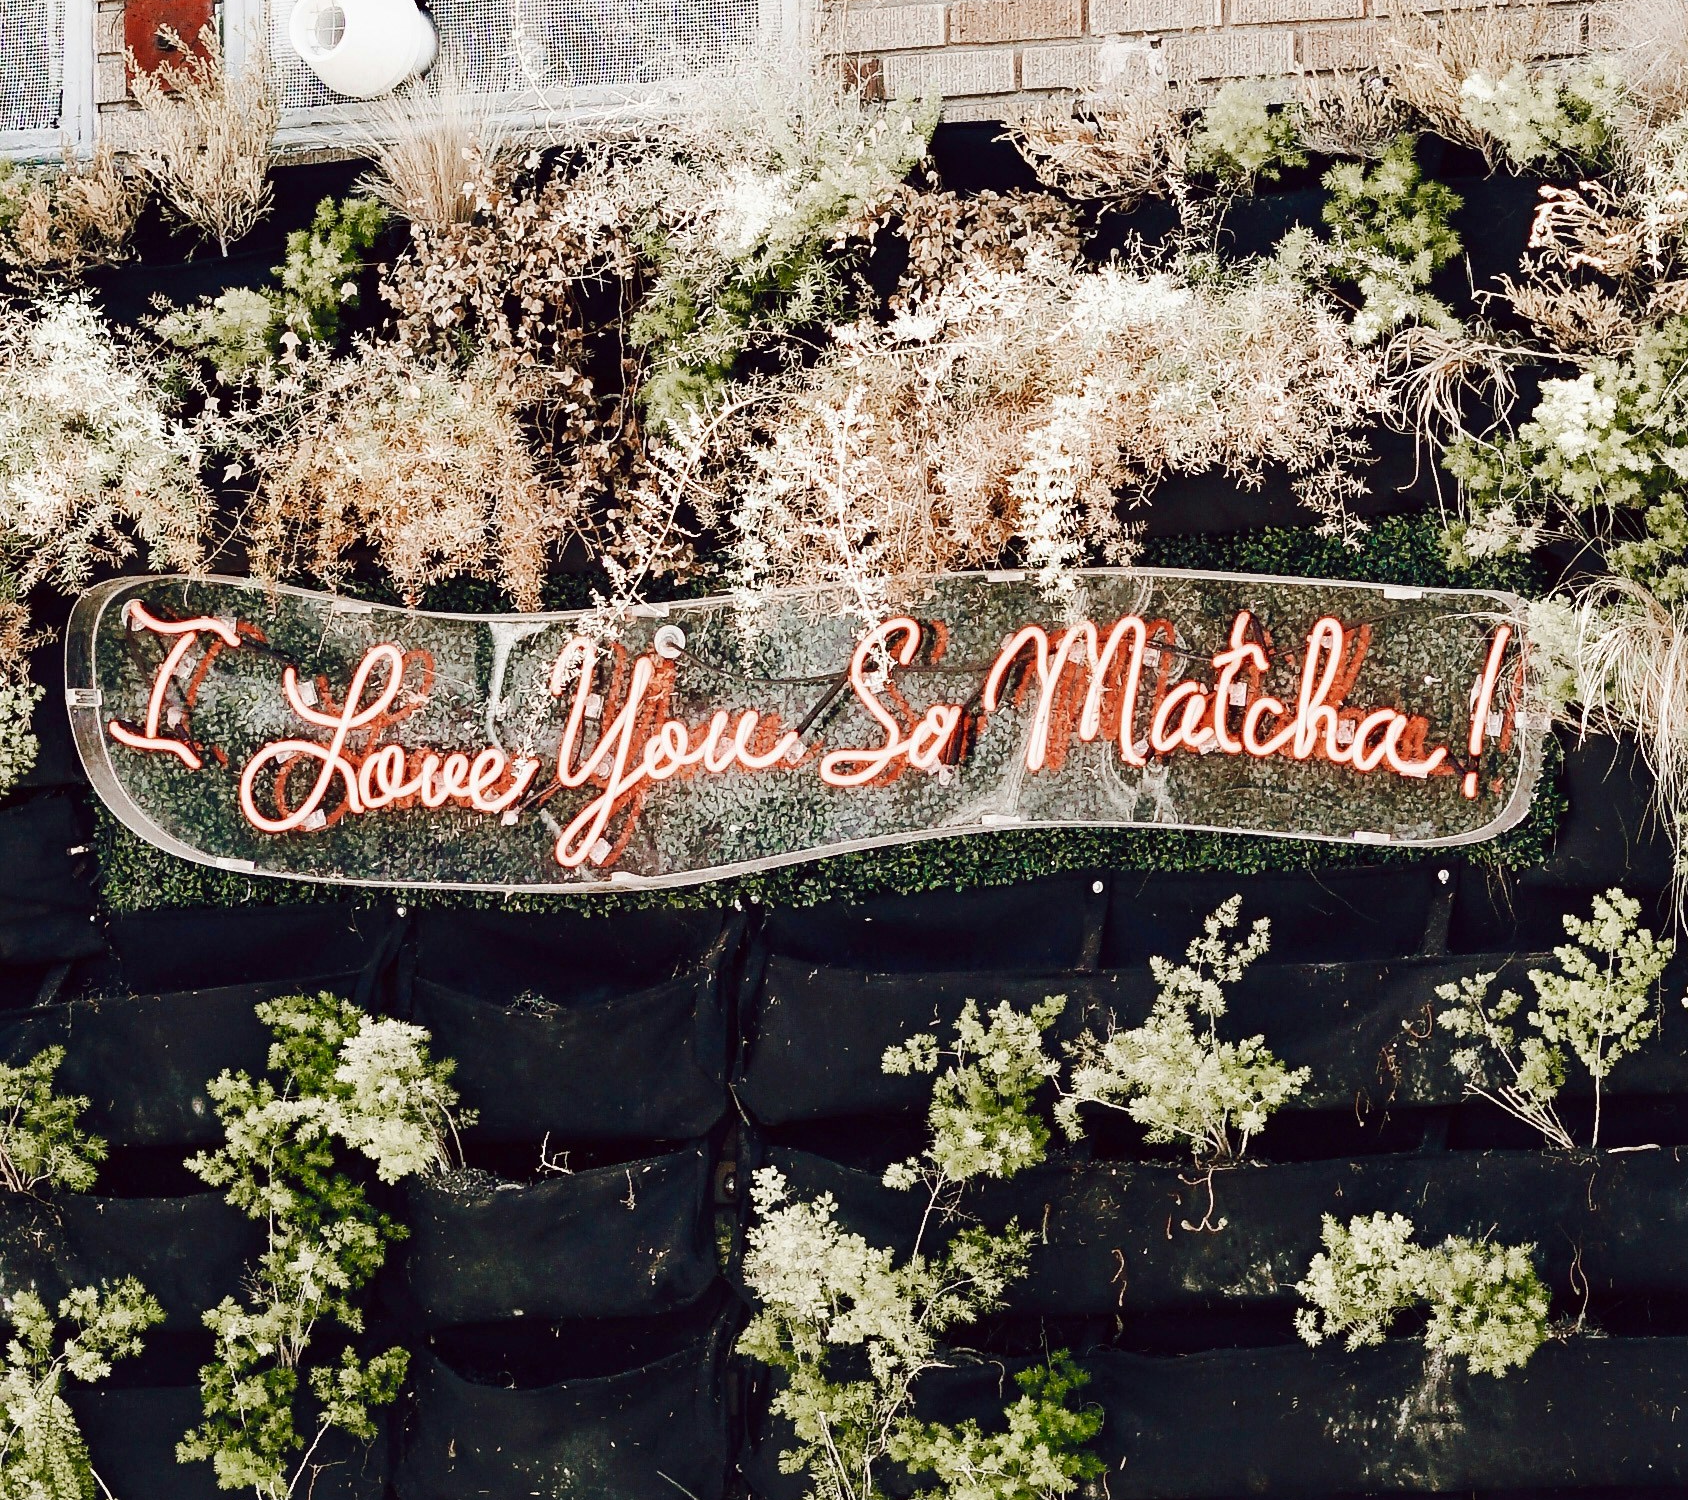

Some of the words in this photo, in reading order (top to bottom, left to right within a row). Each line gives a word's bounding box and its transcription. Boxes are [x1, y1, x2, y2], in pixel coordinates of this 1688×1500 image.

[108, 600, 241, 769] I
[239, 642, 540, 833] Love
[549, 635, 803, 868] You
[820, 615, 964, 787] So
